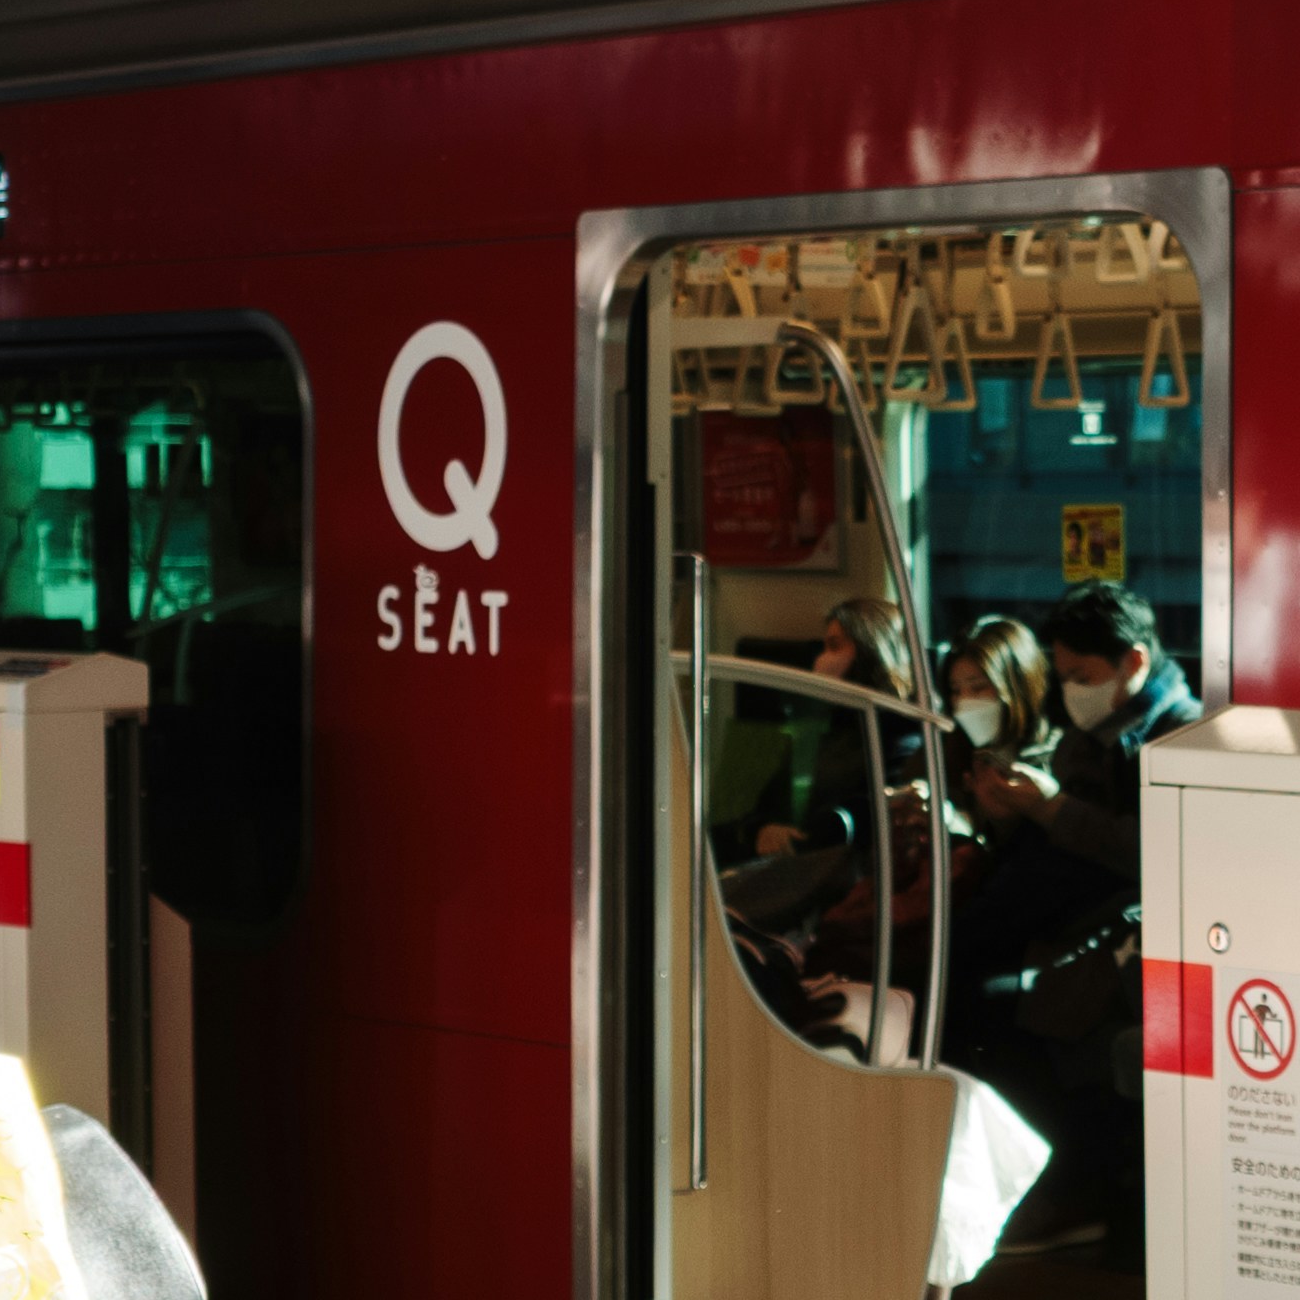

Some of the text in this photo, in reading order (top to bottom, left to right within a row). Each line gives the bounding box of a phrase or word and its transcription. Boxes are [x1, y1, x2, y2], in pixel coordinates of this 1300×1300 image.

[377, 320, 508, 560] Q
[376, 584, 509, 657] SEAT
[1228, 1085, 1297, 1107] のりださない
